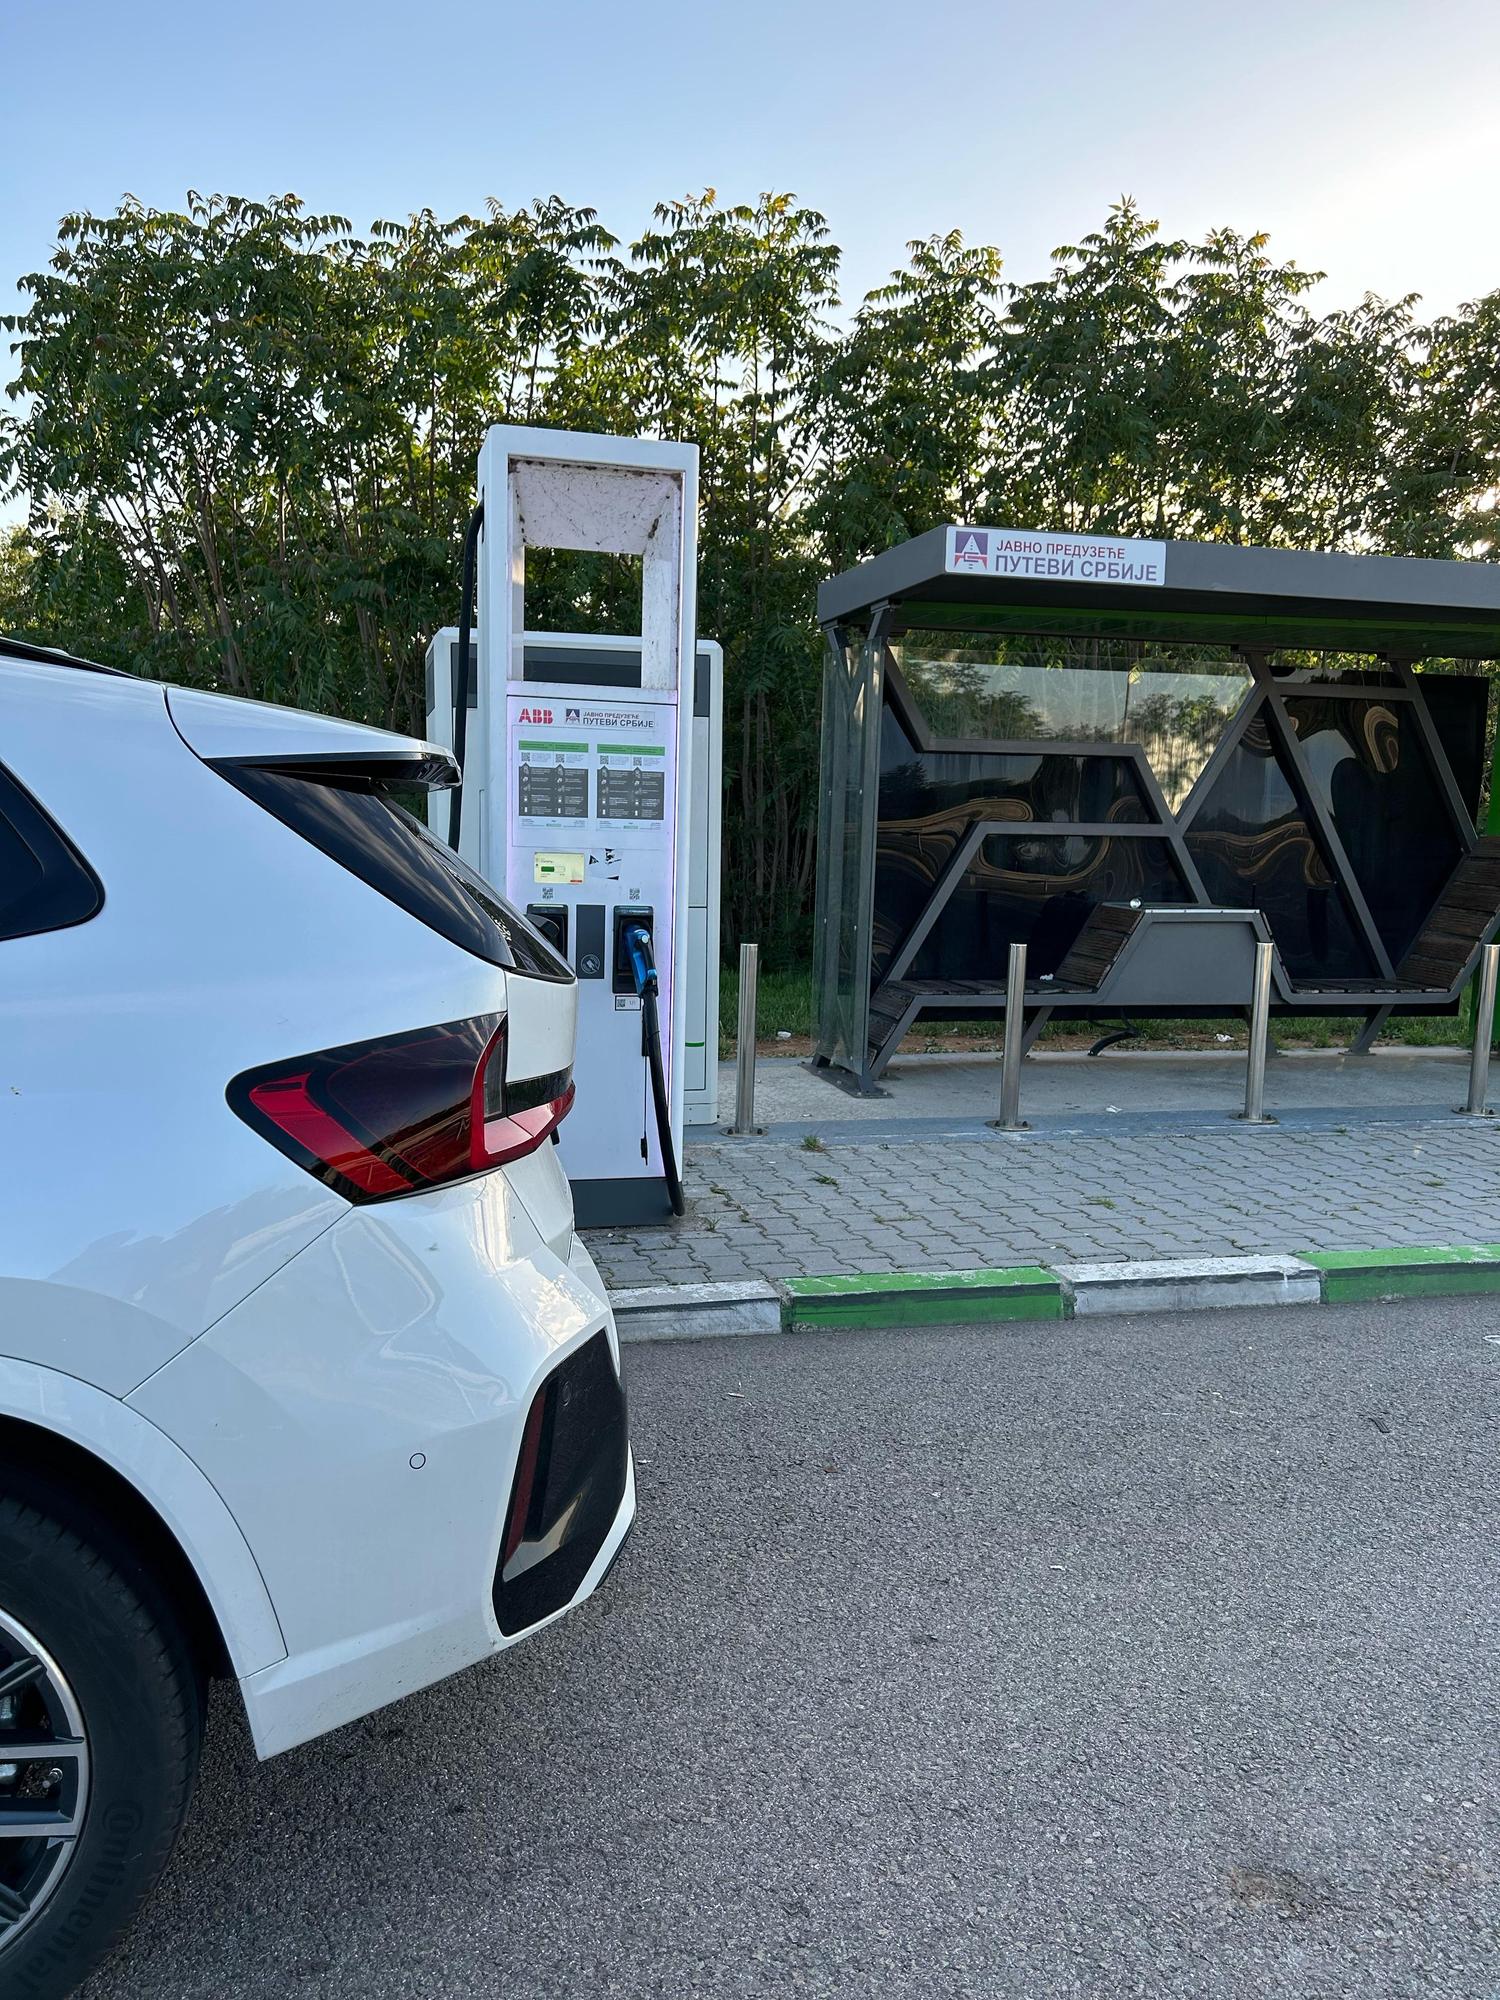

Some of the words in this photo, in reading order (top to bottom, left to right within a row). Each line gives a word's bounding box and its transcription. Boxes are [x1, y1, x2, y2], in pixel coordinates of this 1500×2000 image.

[996, 539, 1042, 554] ЈАВНО
[1046, 543, 1126, 560] ПРЕДУЗЕЋЕ
[995, 555, 1074, 577] ПУТЕВИ
[1080, 561, 1158, 582] СРБИЈЕ
[518, 708, 554, 725] ABB
[582, 717, 618, 726] ПУТЕВИ
[619, 719, 654, 728] СРБИЈЕ
